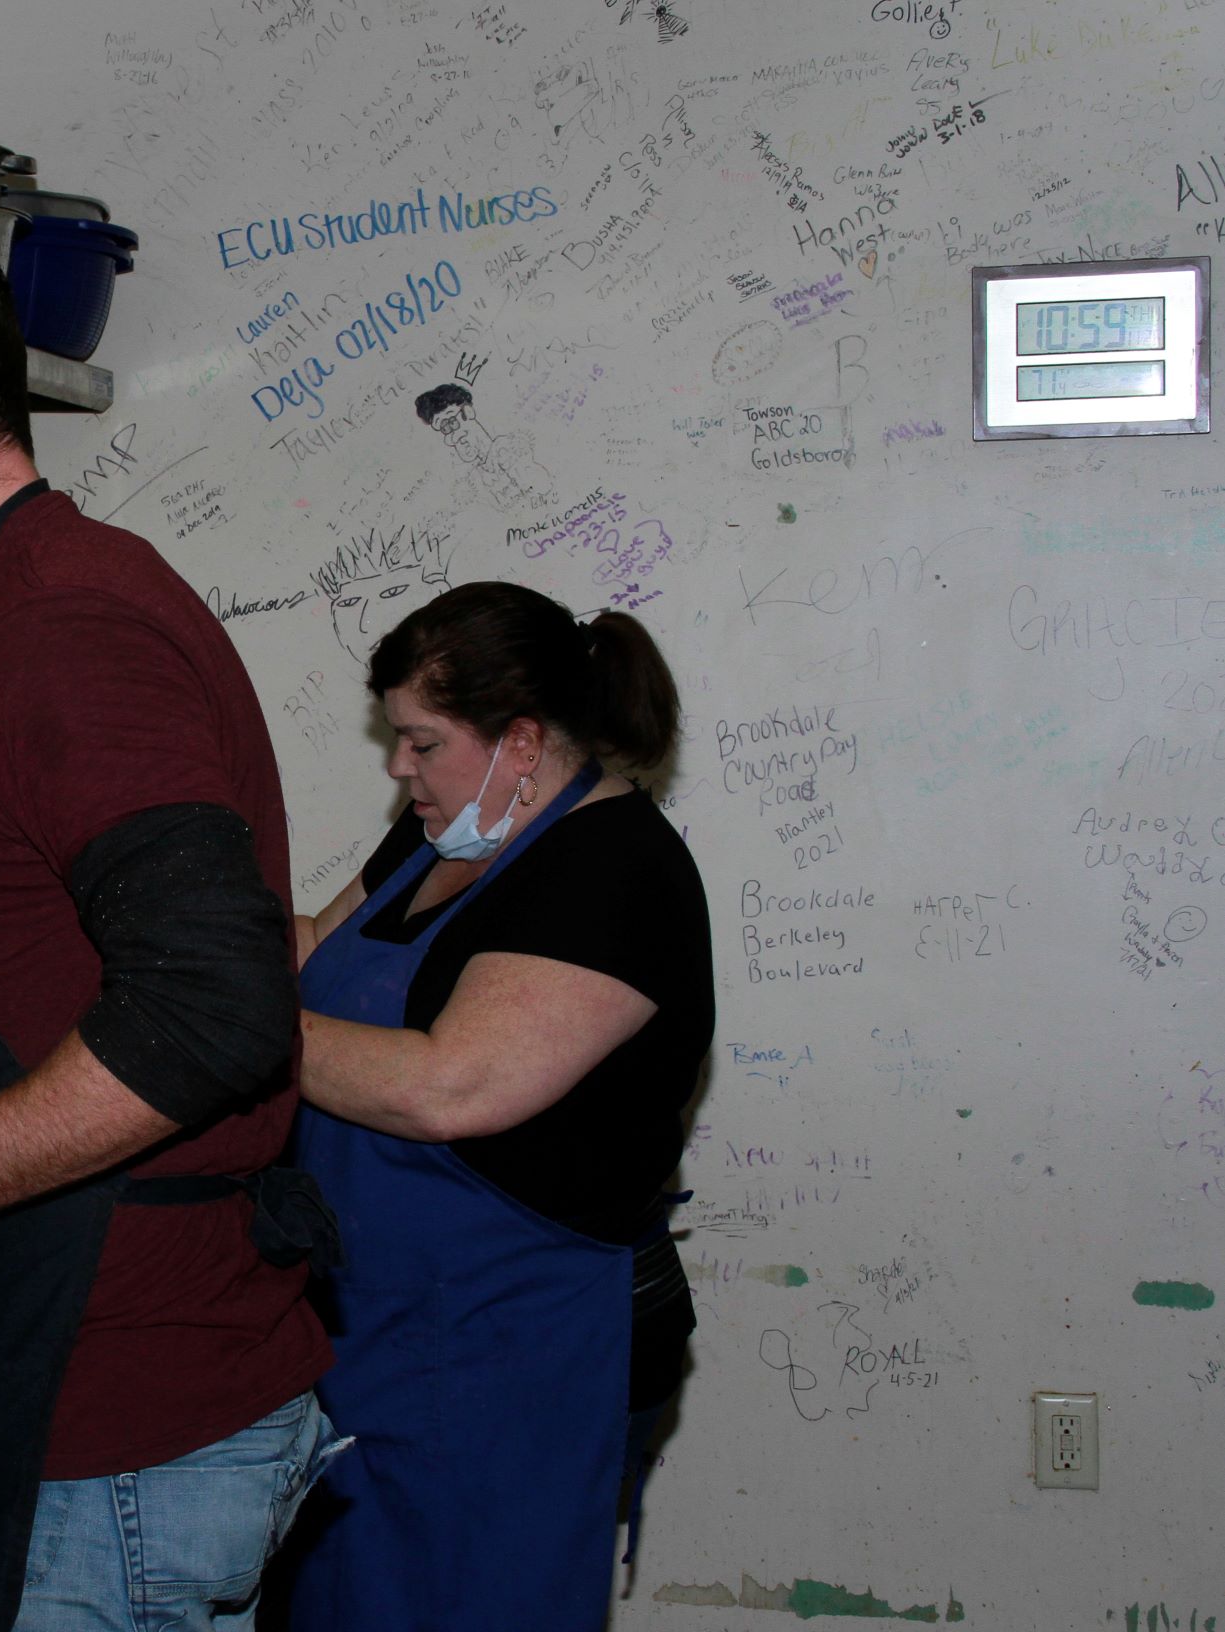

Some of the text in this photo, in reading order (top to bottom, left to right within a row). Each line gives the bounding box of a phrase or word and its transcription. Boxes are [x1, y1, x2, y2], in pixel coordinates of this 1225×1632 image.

[217, 217, 296, 270] ECU
[298, 187, 431, 250] Student
[440, 186, 558, 233] Nurses
[334, 259, 463, 361] 02/18/20
[1036, 303, 1126, 350] 10:59
[743, 404, 794, 422] Towson
[753, 420, 795, 445] ABC
[715, 704, 842, 761] Brookdale
[776, 801, 836, 846] Brantley
[793, 825, 845, 870] 2021
[740, 879, 876, 919] Brookdale
[741, 924, 846, 957] Berkeley
[748, 957, 864, 984] Boulevard
